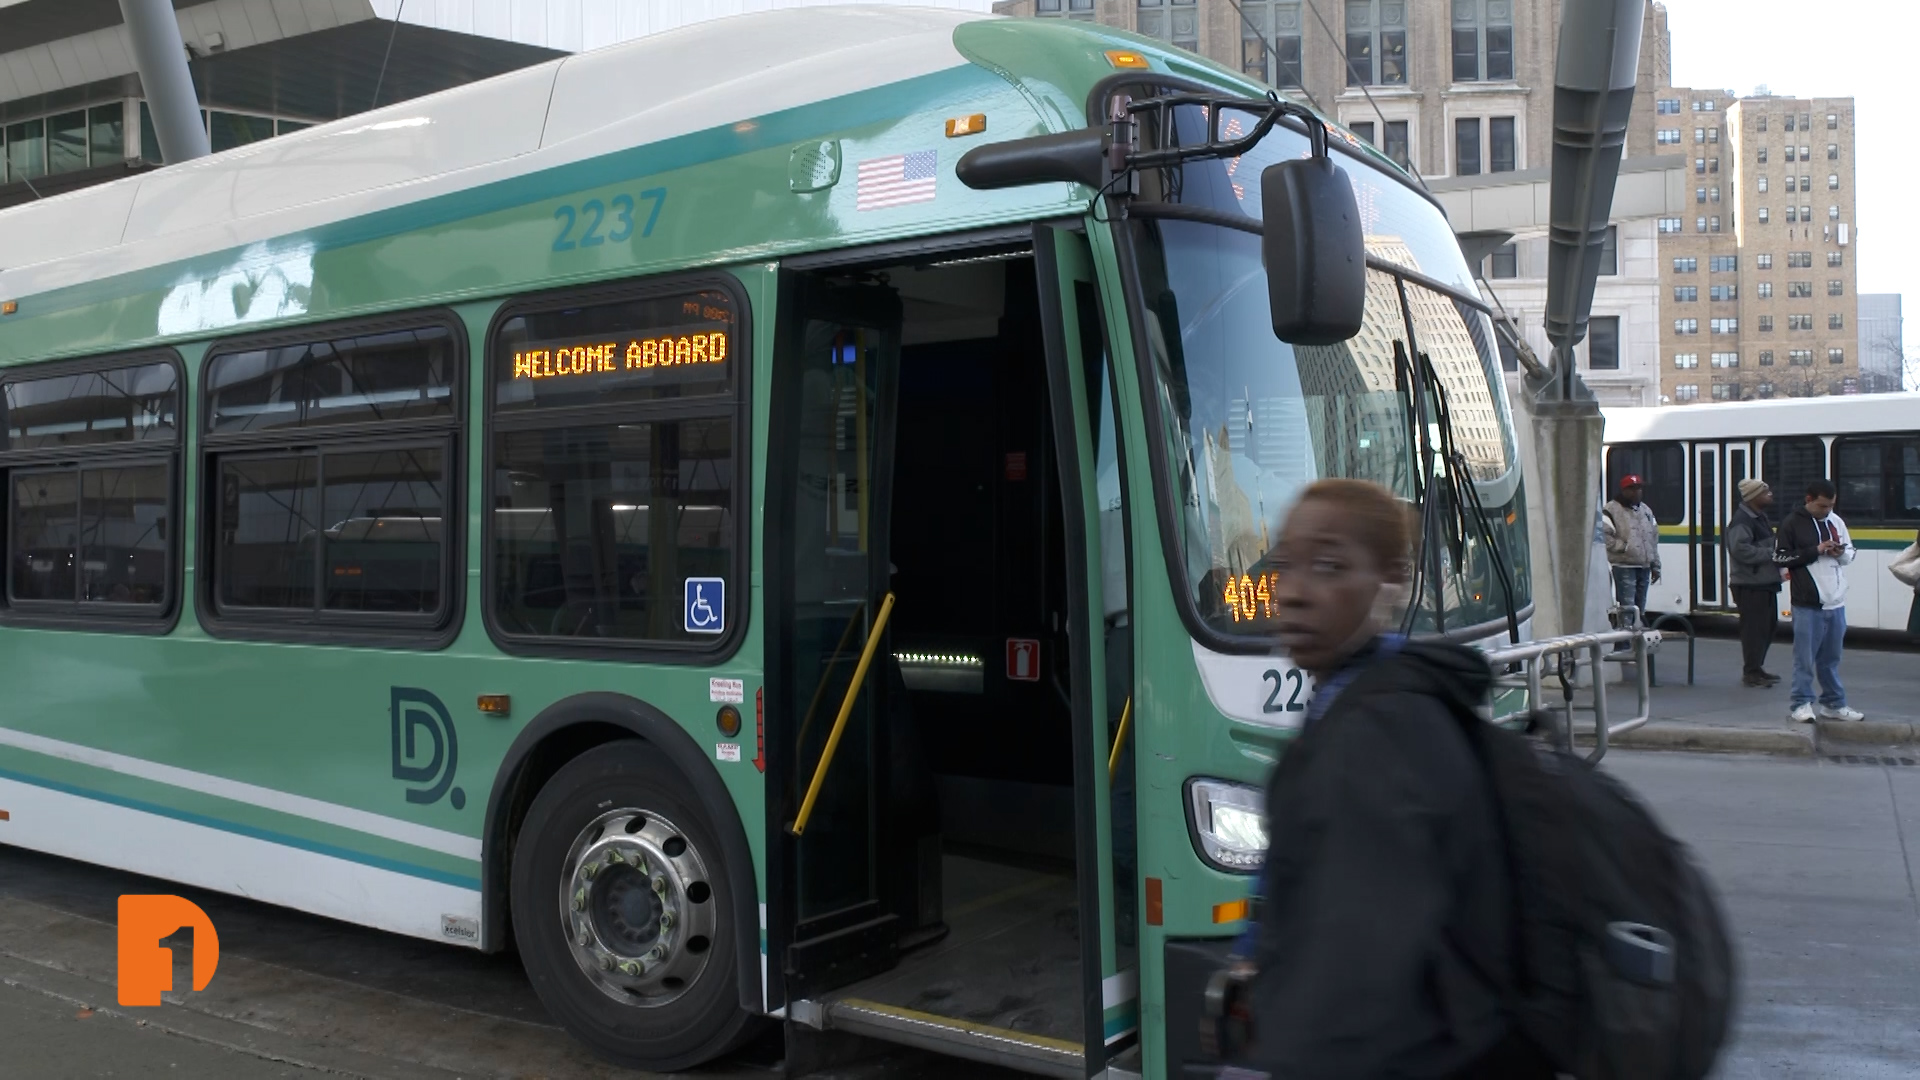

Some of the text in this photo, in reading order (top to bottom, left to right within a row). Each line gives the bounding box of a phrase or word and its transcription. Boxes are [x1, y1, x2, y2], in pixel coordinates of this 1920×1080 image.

[552, 187, 667, 252] 2237
[513, 332, 727, 379] WELCOME ABOARD
